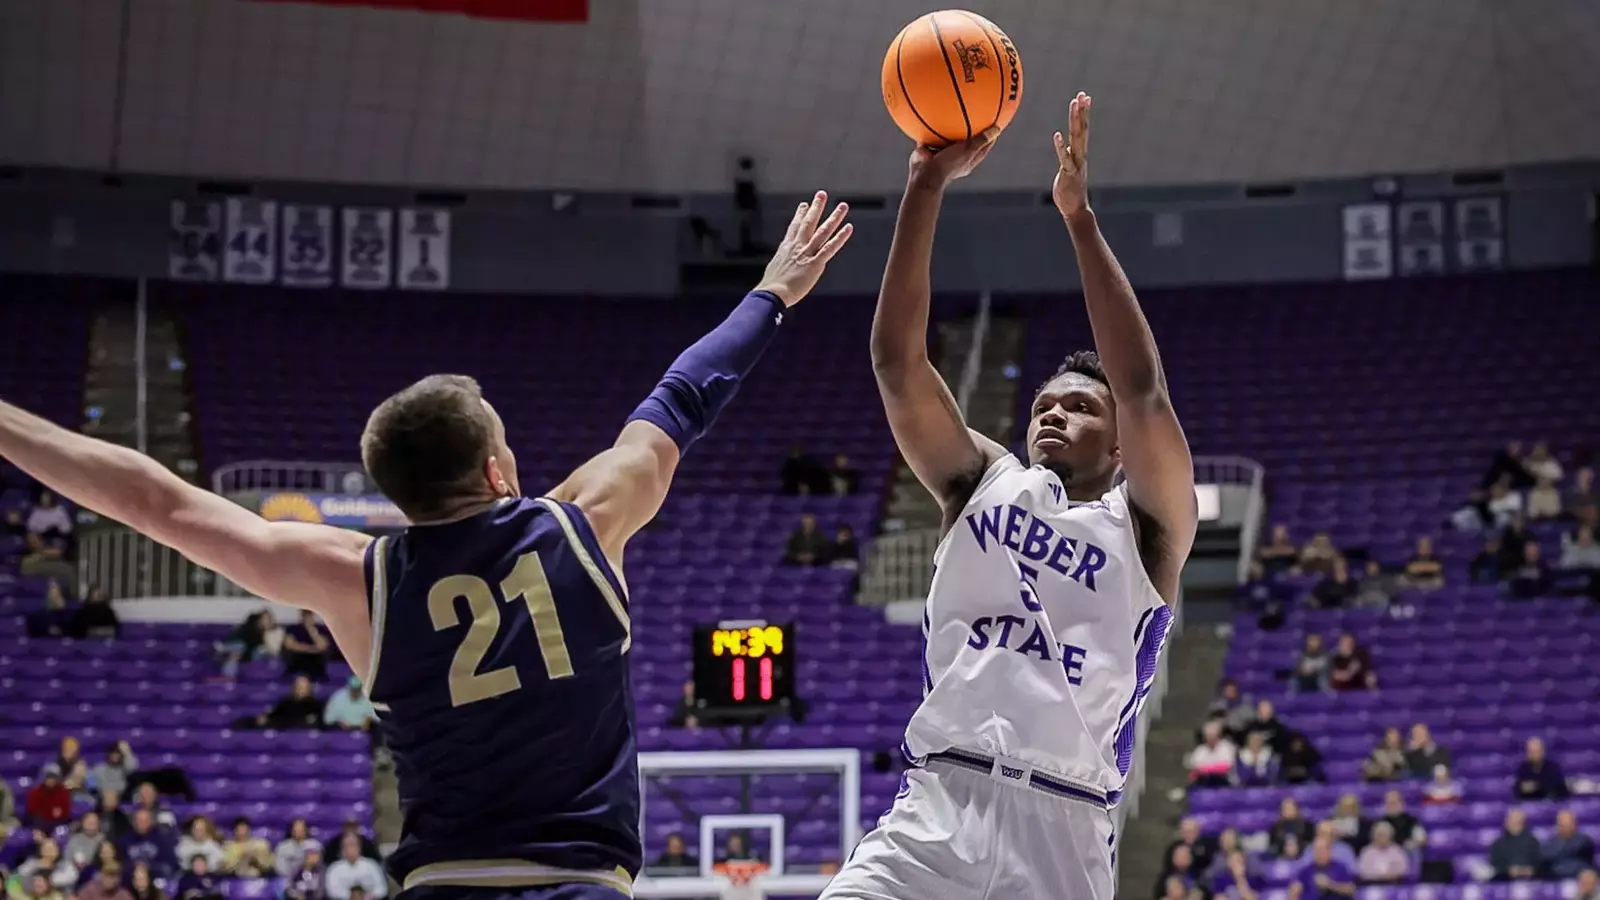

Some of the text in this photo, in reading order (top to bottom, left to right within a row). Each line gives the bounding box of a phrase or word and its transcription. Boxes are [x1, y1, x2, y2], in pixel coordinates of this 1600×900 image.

[226, 230, 269, 260] 44
[350, 236, 385, 265] 22
[966, 504, 1107, 592] WEBER
[1018, 560, 1043, 613] 5
[427, 551, 574, 708] 21
[967, 615, 1087, 686] STAE
[733, 657, 772, 701] 11
[1001, 764, 1024, 780] WSU
